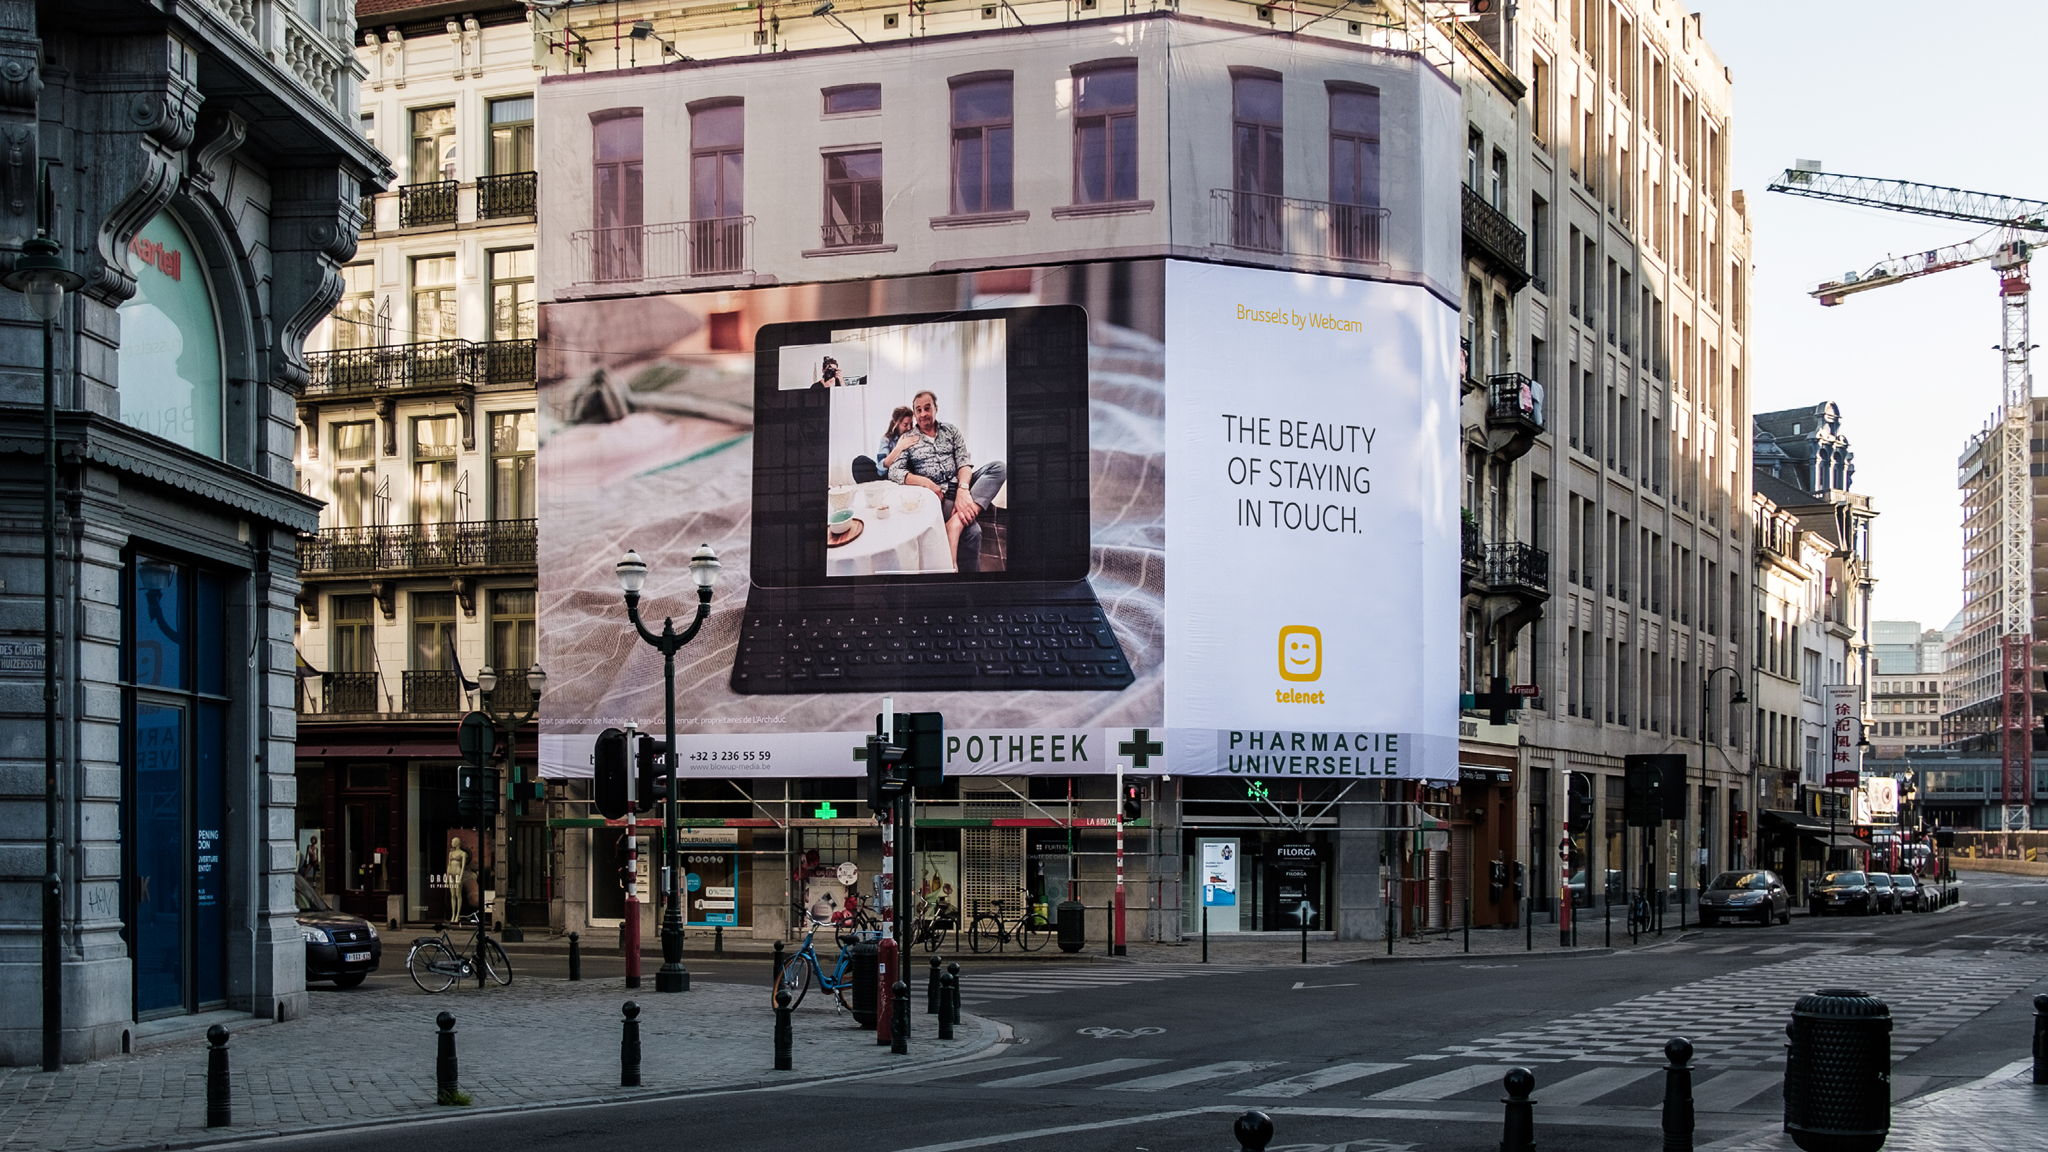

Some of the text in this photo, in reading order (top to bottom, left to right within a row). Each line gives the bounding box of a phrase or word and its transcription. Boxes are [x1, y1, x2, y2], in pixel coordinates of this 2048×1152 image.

[1237, 304, 1363, 333] Brussels by Webcam
[1222, 414, 1376, 454] THE BEAUTY
[1228, 457, 1371, 495] OF STAYING
[1238, 499, 1363, 534] IN TOUCH.
[1275, 688, 1326, 704] telenet
[675, 717, 700, 726] ennart,
[947, 735, 1088, 763] POTHEEK
[1230, 731, 1398, 752] PHARMACIE
[690, 751, 708, 761] +32
[712, 751, 717, 761] 3
[721, 751, 739, 761] 236
[743, 751, 755, 761] 55
[759, 751, 771, 761] 59
[1228, 755, 1397, 776] UNIVERSELLE
[1087, 818, 1095, 826] LA
[198, 829, 219, 840] PENING
[1277, 848, 1317, 856] FILORGA
[430, 873, 460, 883] DRÔLE
